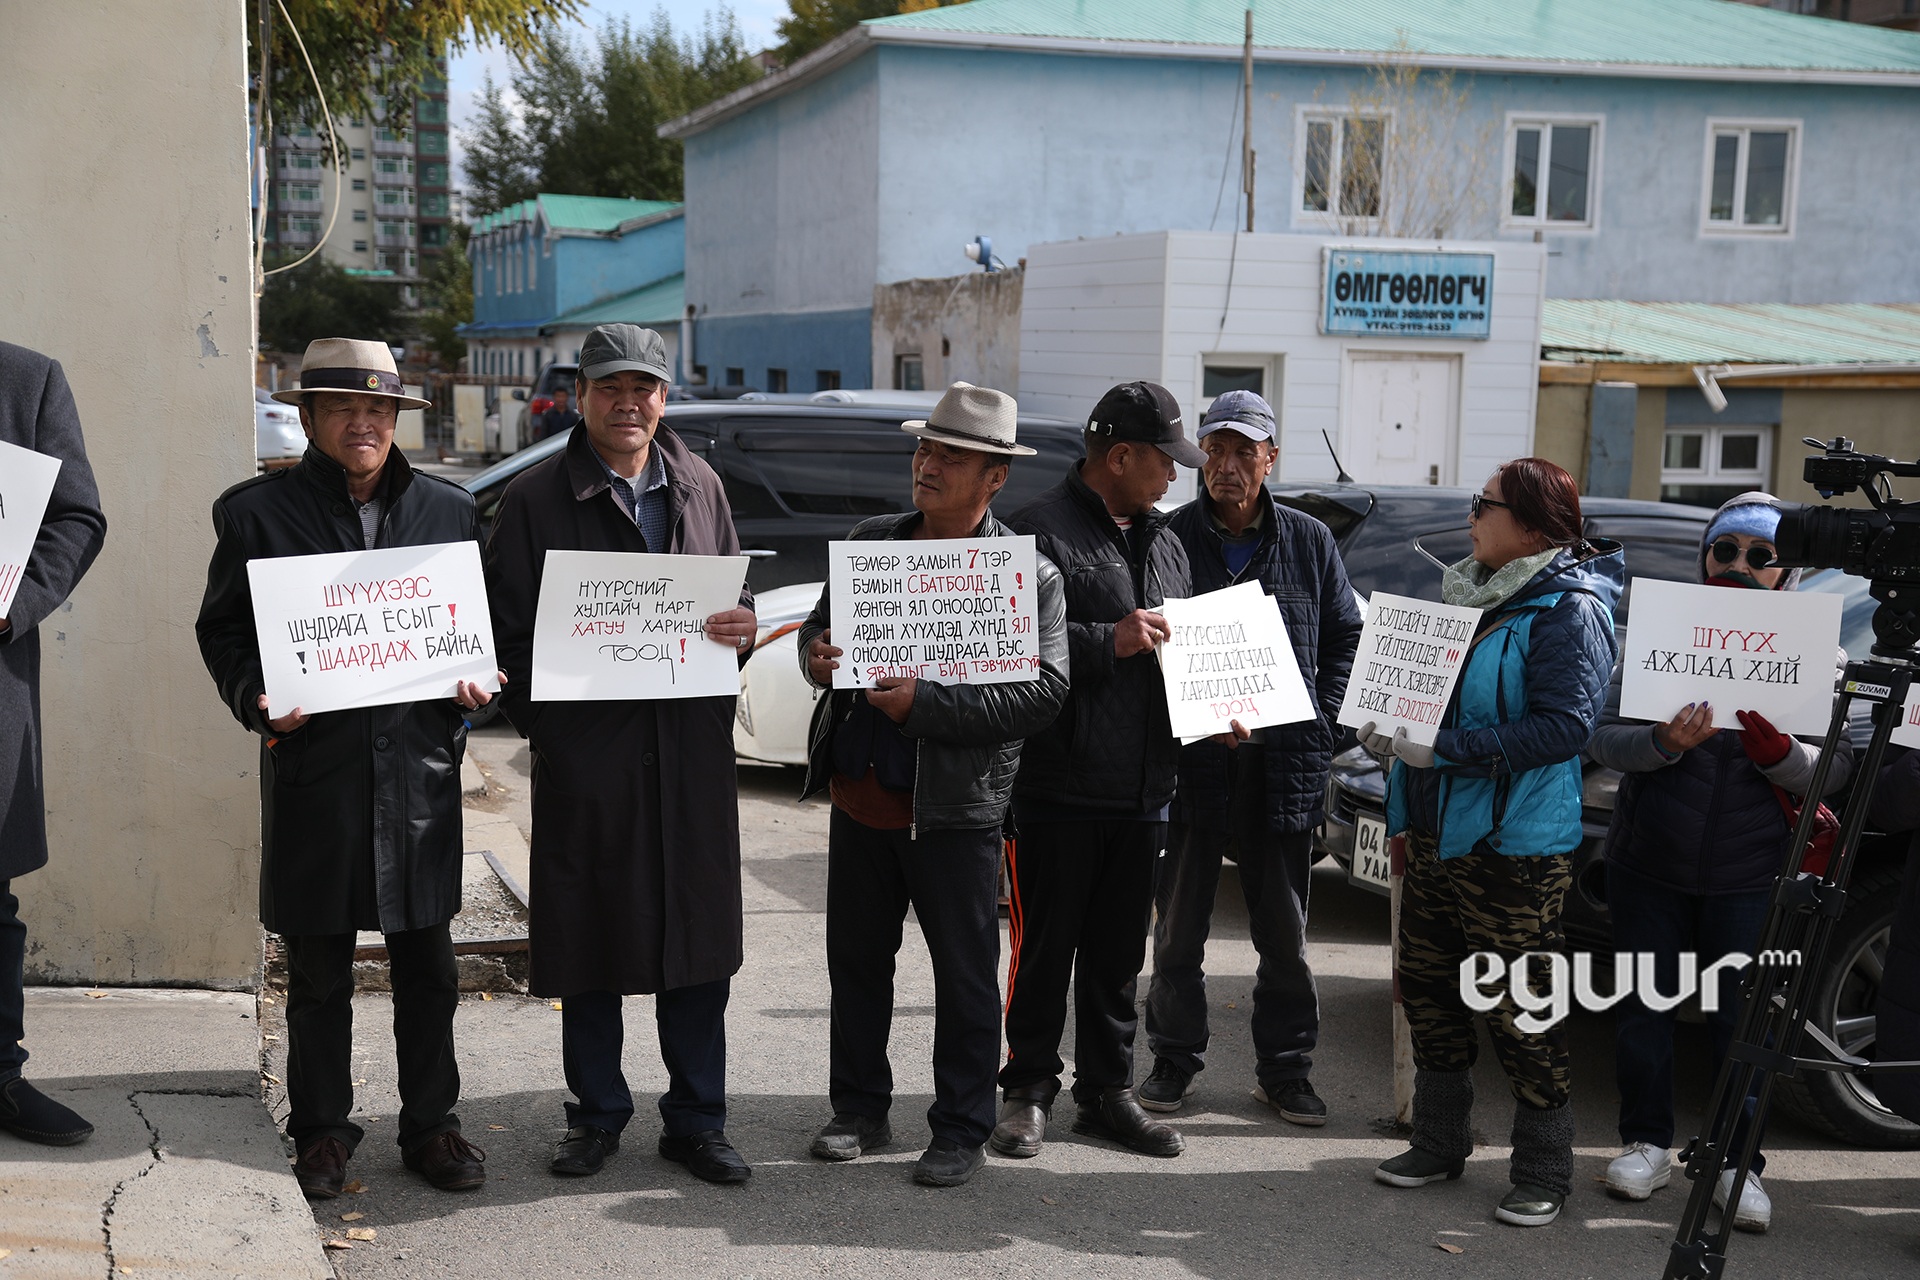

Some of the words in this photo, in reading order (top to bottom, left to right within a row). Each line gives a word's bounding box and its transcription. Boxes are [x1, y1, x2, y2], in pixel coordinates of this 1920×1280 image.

[1335, 270, 1486, 305] ӨМГӨӨЛӨГЧ
[847, 555, 901, 572] ТӨМӨР
[906, 553, 962, 570] ЗАМЫН
[324, 576, 432, 608] ШҮҮХЭЭС
[579, 577, 674, 598] НҮҮРСНИЙ
[852, 578, 902, 595] БУМЫН
[574, 598, 641, 618] ХУЛГАЙЧ
[655, 600, 695, 615] НАРТ
[852, 601, 903, 618] ХӨНГӨН
[908, 599, 928, 616] ЯЛ
[1372, 606, 1431, 635] ХУЛГАЙЧ
[287, 612, 369, 648] ШУДРАГА
[571, 620, 626, 637] ХАТУУ
[852, 623, 894, 645] АРДЫН
[900, 620, 962, 644] ХҮҮХДЭД
[968, 618, 1007, 640] ХҮНД
[1011, 617, 1031, 634] ЯЛ
[1174, 619, 1248, 647] НҮҮРСНИЙ
[1693, 626, 1778, 654] ШҮҮХ
[425, 626, 484, 660] БАЙНА
[852, 645, 918, 668] ОНООДОГ
[924, 642, 990, 665] ШУДРАГА
[997, 639, 1025, 658] БУС
[938, 662, 968, 683] БИД
[1187, 646, 1278, 674] ХУЛГАЙЧИД
[1744, 654, 1801, 685] ХИЙ
[1180, 673, 1275, 701] ХАРИУЦЛАГА
[1365, 661, 1404, 688] ШҮҮХ
[1357, 686, 1393, 715] БАЙЖ
[1857, 684, 1889, 696] ZUV.MN
[1210, 697, 1260, 719] ТООЦ
